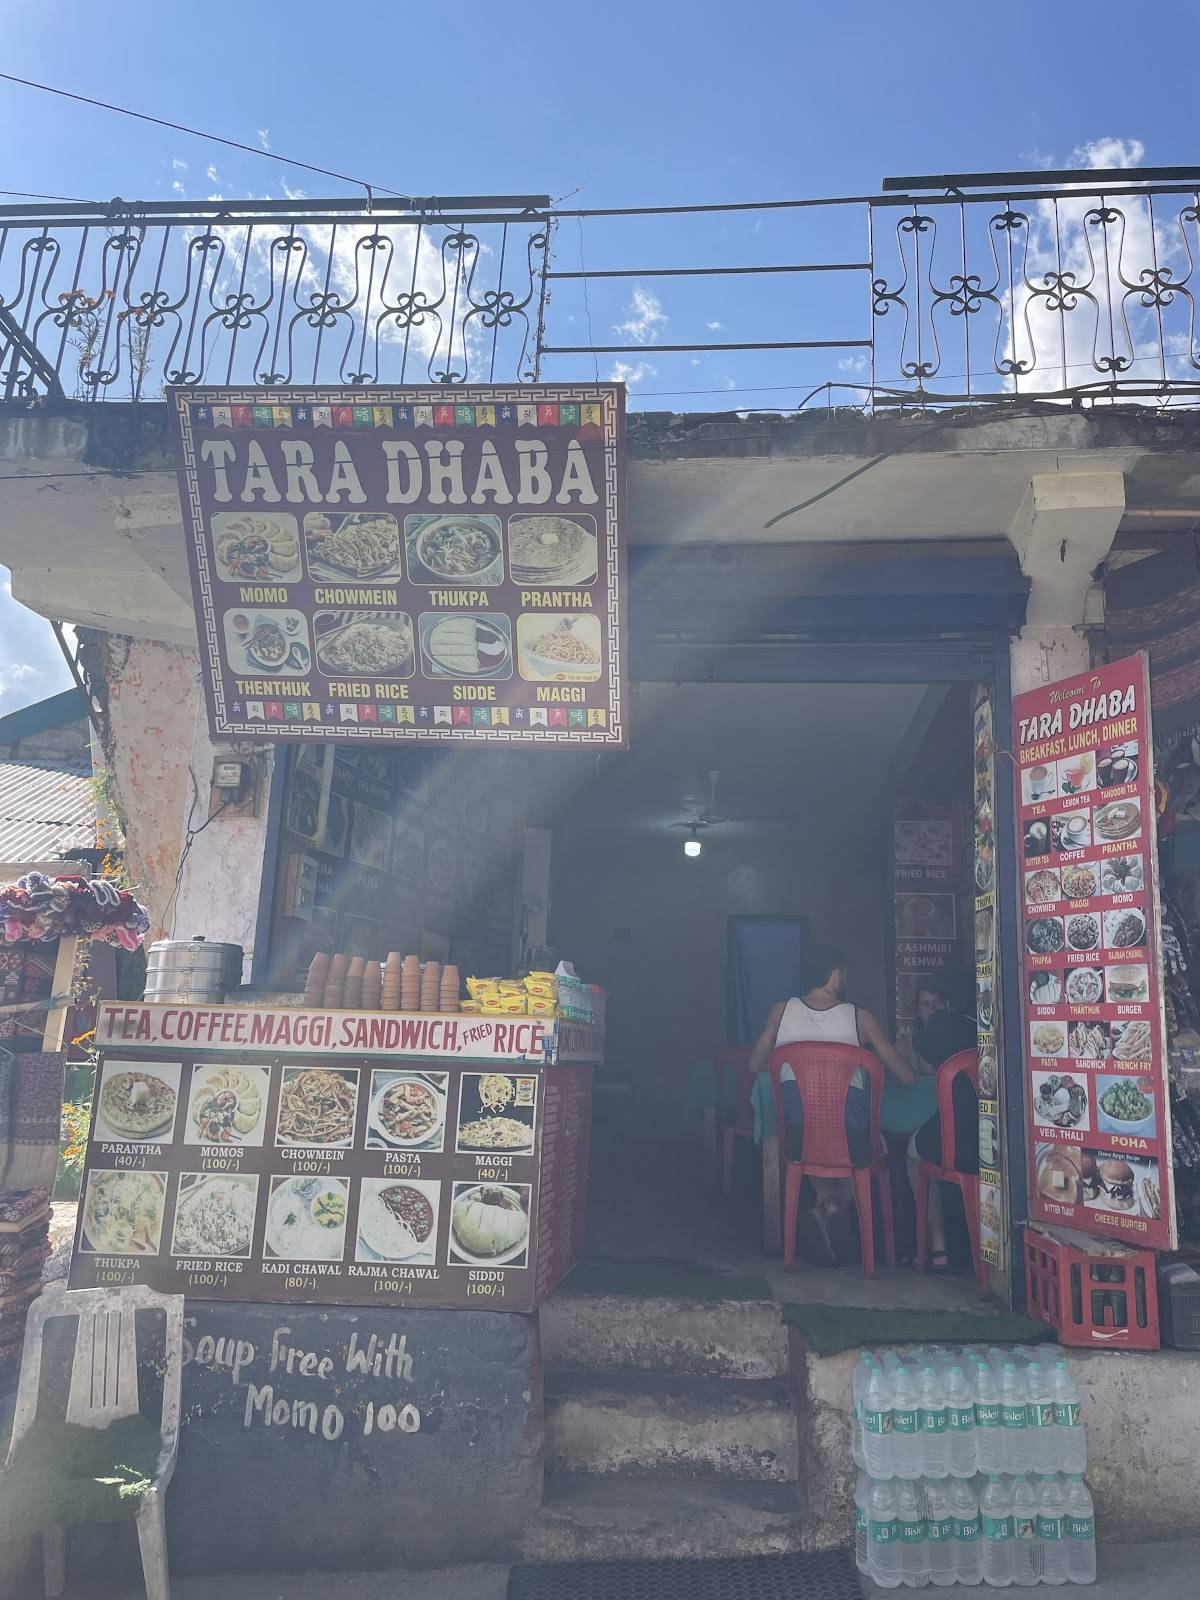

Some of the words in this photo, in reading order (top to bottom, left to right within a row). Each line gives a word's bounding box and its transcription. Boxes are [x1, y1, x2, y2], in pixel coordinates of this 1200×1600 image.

[201, 440, 367, 503] TARA
[382, 439, 599, 504] DHABA
[240, 587, 288, 603] MOMO
[314, 588, 398, 605] CHOWMEIN
[429, 590, 489, 607] THUKPA
[521, 591, 593, 608] PRANTHA
[235, 680, 311, 697] THENTHUK
[328, 682, 370, 698] FRIED
[375, 683, 409, 699] RICE
[453, 685, 496, 701] SIDDE
[536, 686, 586, 702] MAGGI
[1049, 685, 1086, 704] Welcome
[1090, 676, 1102, 690] To
[1018, 708, 1063, 745] TARA
[1069, 684, 1136, 730] DHABA
[1020, 737, 1067, 765] BREAKFAST,
[1068, 729, 1101, 751] LUNCH,
[1103, 717, 1138, 741] DINNER
[1100, 785, 1127, 799] TANDOORI
[1127, 784, 1138, 794] TEA
[1062, 798, 1080, 808] LEMON
[1080, 794, 1091, 805] TEA
[1032, 805, 1046, 815] TEA
[1102, 840, 1138, 854] PRANTHA
[1059, 850, 1085, 861] COFFEE
[1069, 899, 1089, 909] MAGGI
[1112, 893, 1134, 904] MOMO
[1067, 953, 1085, 963] FRIED
[1086, 952, 1100, 962] RICE
[1117, 1005, 1142, 1015] BURGER
[462, 1023, 493, 1046] FRIED
[493, 1024, 545, 1055] RICE
[1040, 1058, 1058, 1067] PASTA
[1075, 1059, 1106, 1069] SANDWICH
[1114, 1060, 1139, 1070] FRENCH
[1140, 1061, 1152, 1071] FRY
[1040, 1127, 1058, 1139] VEG.
[1060, 1129, 1084, 1141] THALI
[1111, 1135, 1148, 1149] POHA
[100, 1143, 162, 1156] PARANTHA
[201, 1146, 244, 1158] MOMOS
[281, 1149, 345, 1160] CHOWMEIN
[114, 1156, 146, 1168] (40/-)
[202, 1158, 240, 1171] (100/-)
[385, 1152, 421, 1164] PASTA
[475, 1155, 513, 1167] MAGGI
[293, 1160, 331, 1173] (100/-)
[383, 1164, 421, 1177] (100/-)
[477, 1168, 508, 1181] (40/-)
[1094, 1212, 1119, 1226] CHEESE
[1120, 1217, 1147, 1232] BURGER
[94, 1257, 140, 1269] THUKPA
[175, 1260, 211, 1271] FRIED
[215, 1261, 243, 1273] RICE
[261, 1263, 290, 1274] KADI
[293, 1264, 342, 1276] CHAWAL
[96, 1271, 135, 1284] (100/-)
[348, 1266, 388, 1278] RAJMA
[391, 1268, 440, 1280] CHAWAL
[468, 1270, 504, 1281] SIDDU
[189, 1274, 227, 1287] (100/-)
[374, 1280, 412, 1293] (100/-)
[466, 1283, 505, 1296] (100/-)
[269, 1327, 334, 1380] Free
[345, 1332, 416, 1382] With
[363, 1401, 420, 1436] 100
